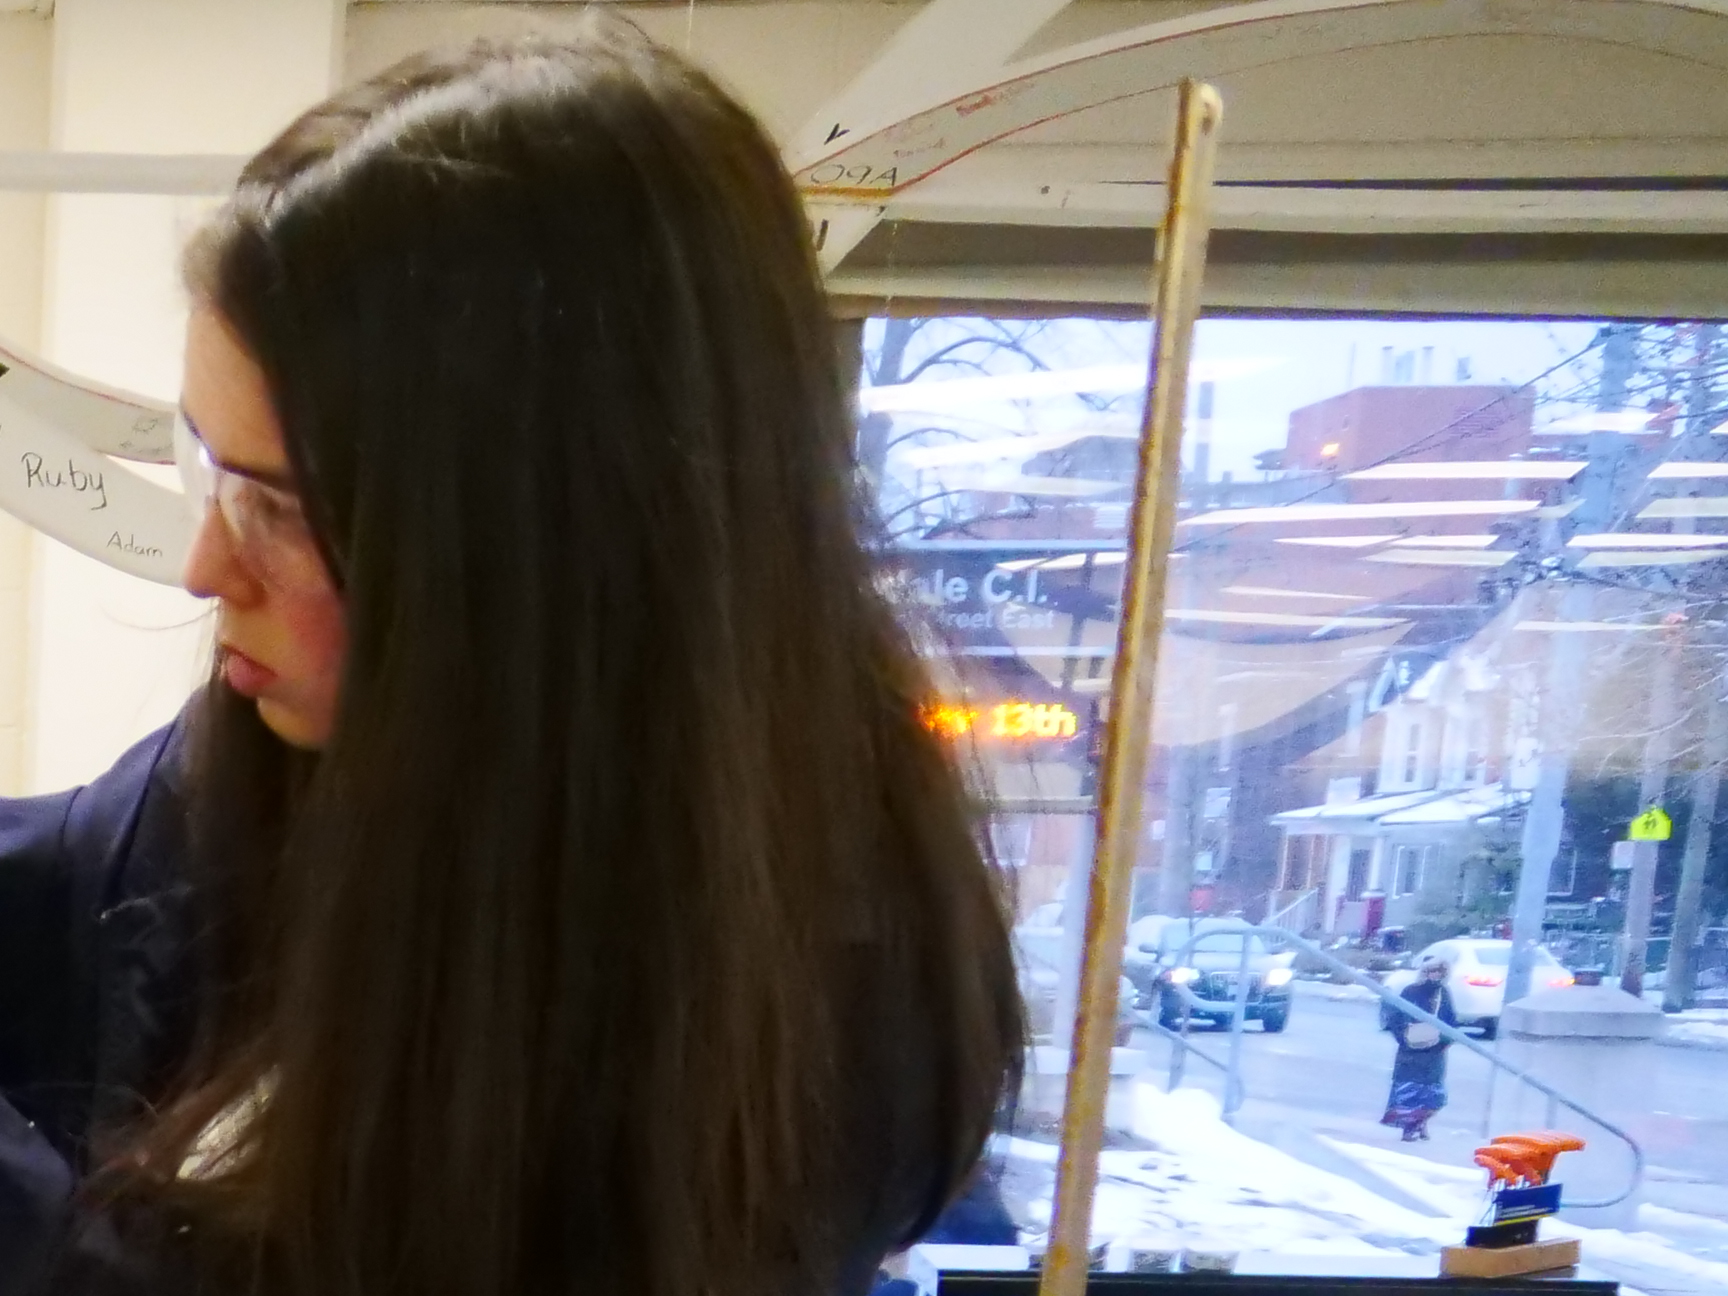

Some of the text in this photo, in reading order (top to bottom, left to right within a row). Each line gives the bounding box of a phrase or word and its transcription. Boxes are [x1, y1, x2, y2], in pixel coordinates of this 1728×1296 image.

[21, 452, 107, 510] Ruby
[106, 531, 164, 557] Adam
[992, 702, 1077, 737] 13th
